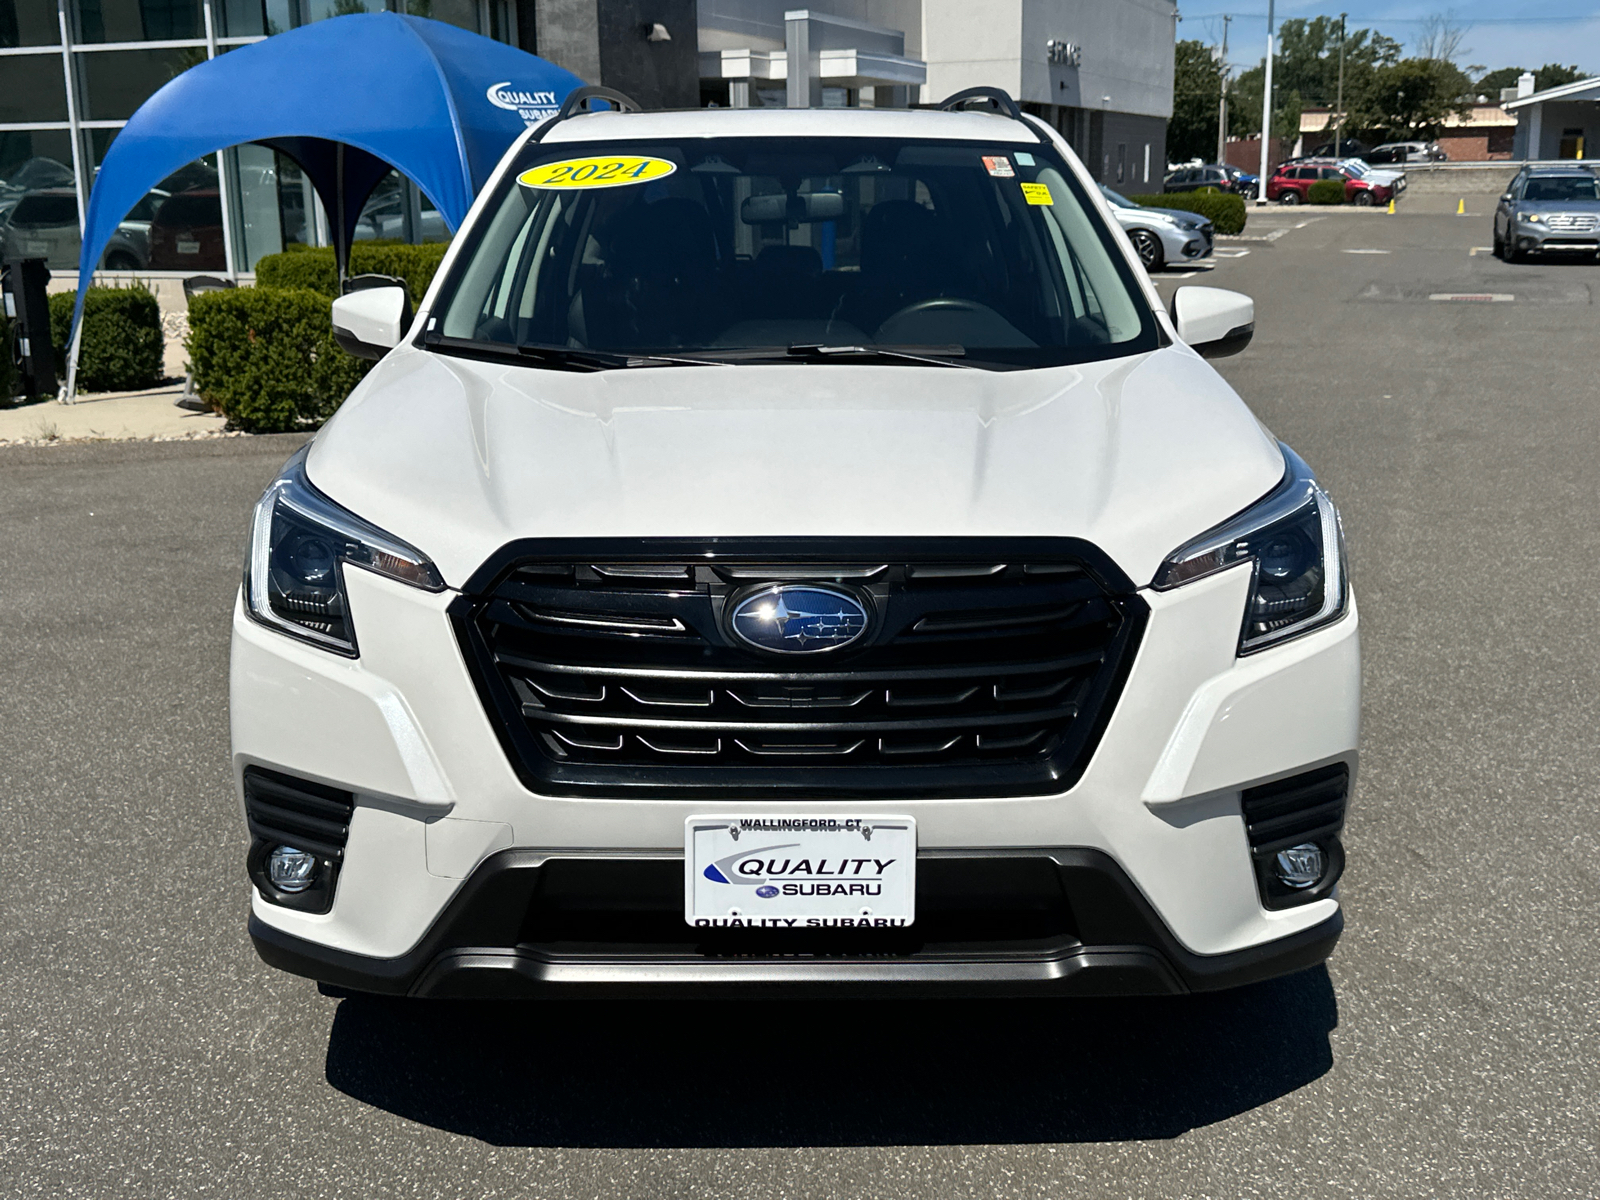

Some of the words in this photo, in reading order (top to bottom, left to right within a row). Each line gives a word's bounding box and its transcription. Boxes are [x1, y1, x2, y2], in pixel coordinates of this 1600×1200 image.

[498, 90, 556, 104] QUALITY
[518, 109, 560, 119] SUBAR
[542, 161, 651, 184] 2024
[740, 818, 840, 829] WALLINGFORD,
[845, 818, 862, 828] CT
[738, 859, 897, 876] QUALITY
[782, 884, 882, 896] SUBARU
[694, 918, 798, 928] QUALITY
[805, 918, 906, 928] SUBARU
